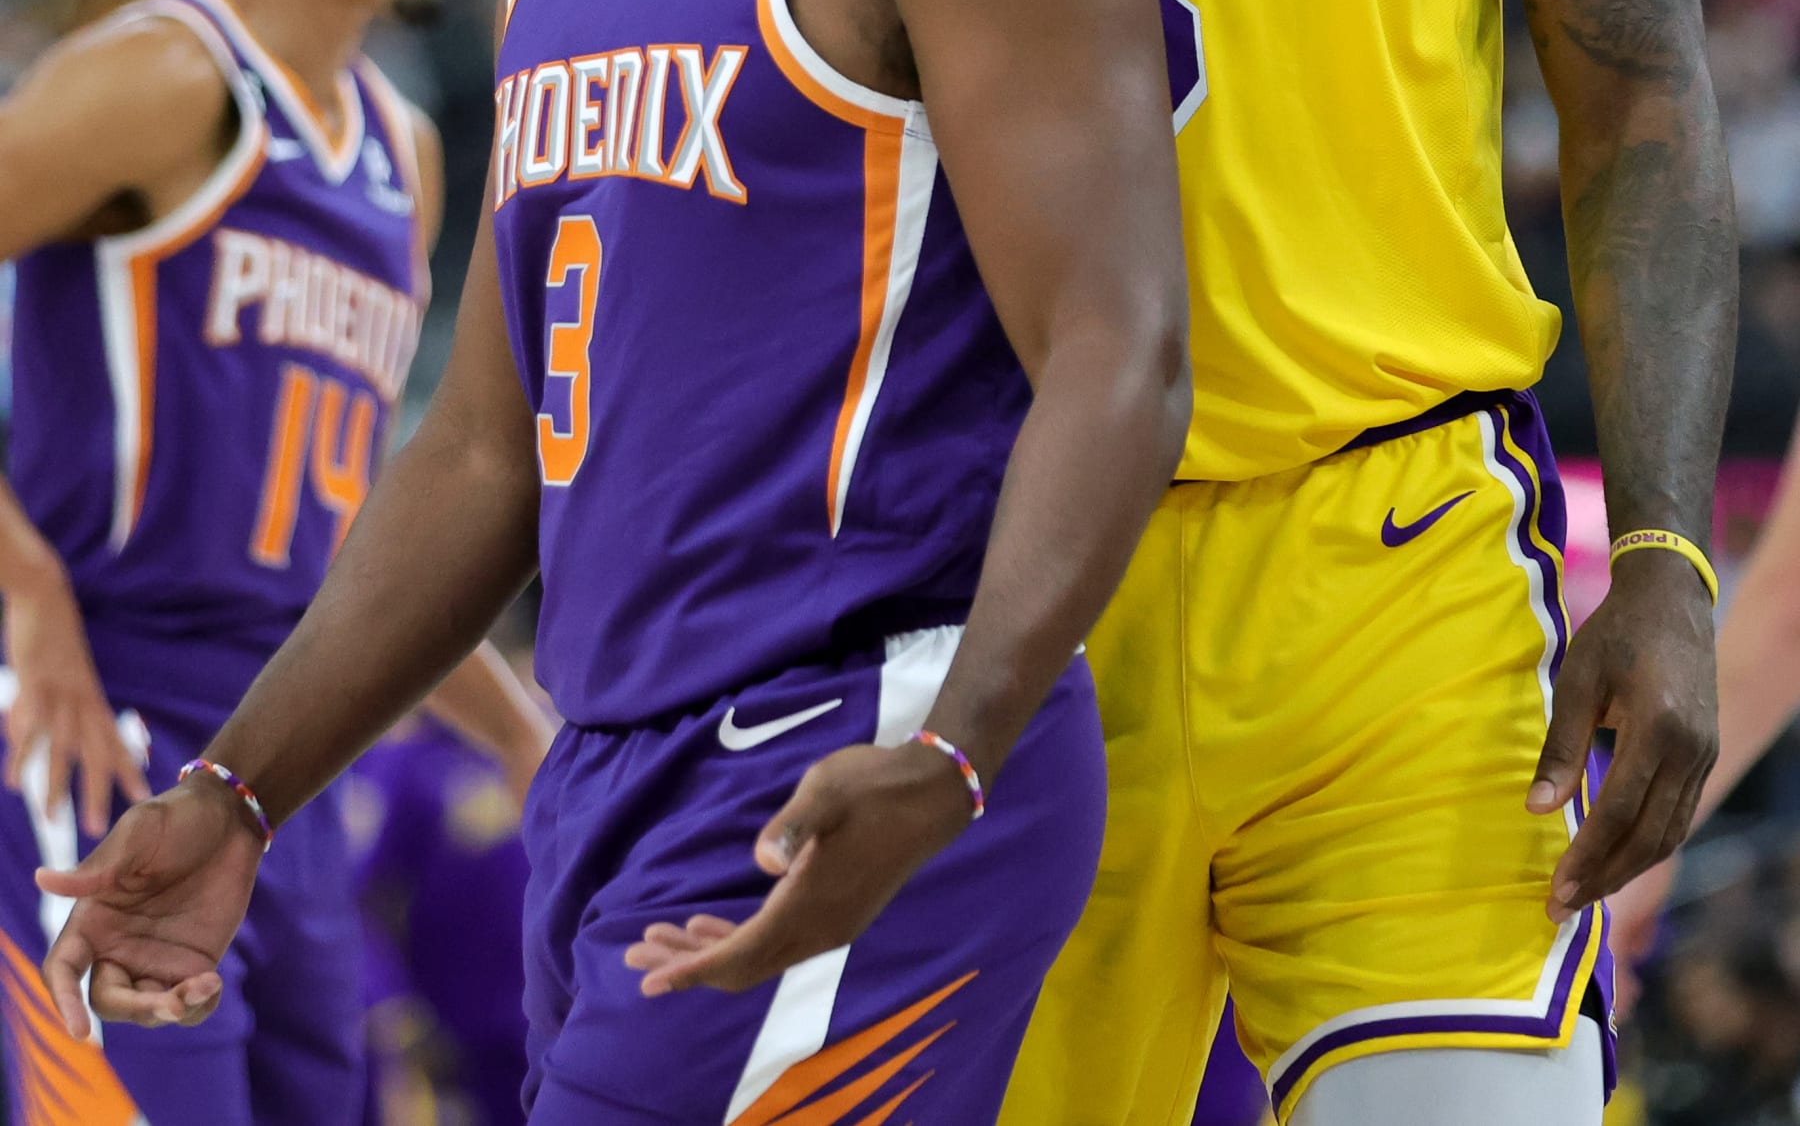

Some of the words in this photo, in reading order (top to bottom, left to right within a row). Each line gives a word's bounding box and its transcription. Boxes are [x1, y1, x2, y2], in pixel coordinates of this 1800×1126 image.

[494, 43, 749, 211] HOENIX
[536, 214, 602, 487] 3
[247, 361, 380, 572] 14
